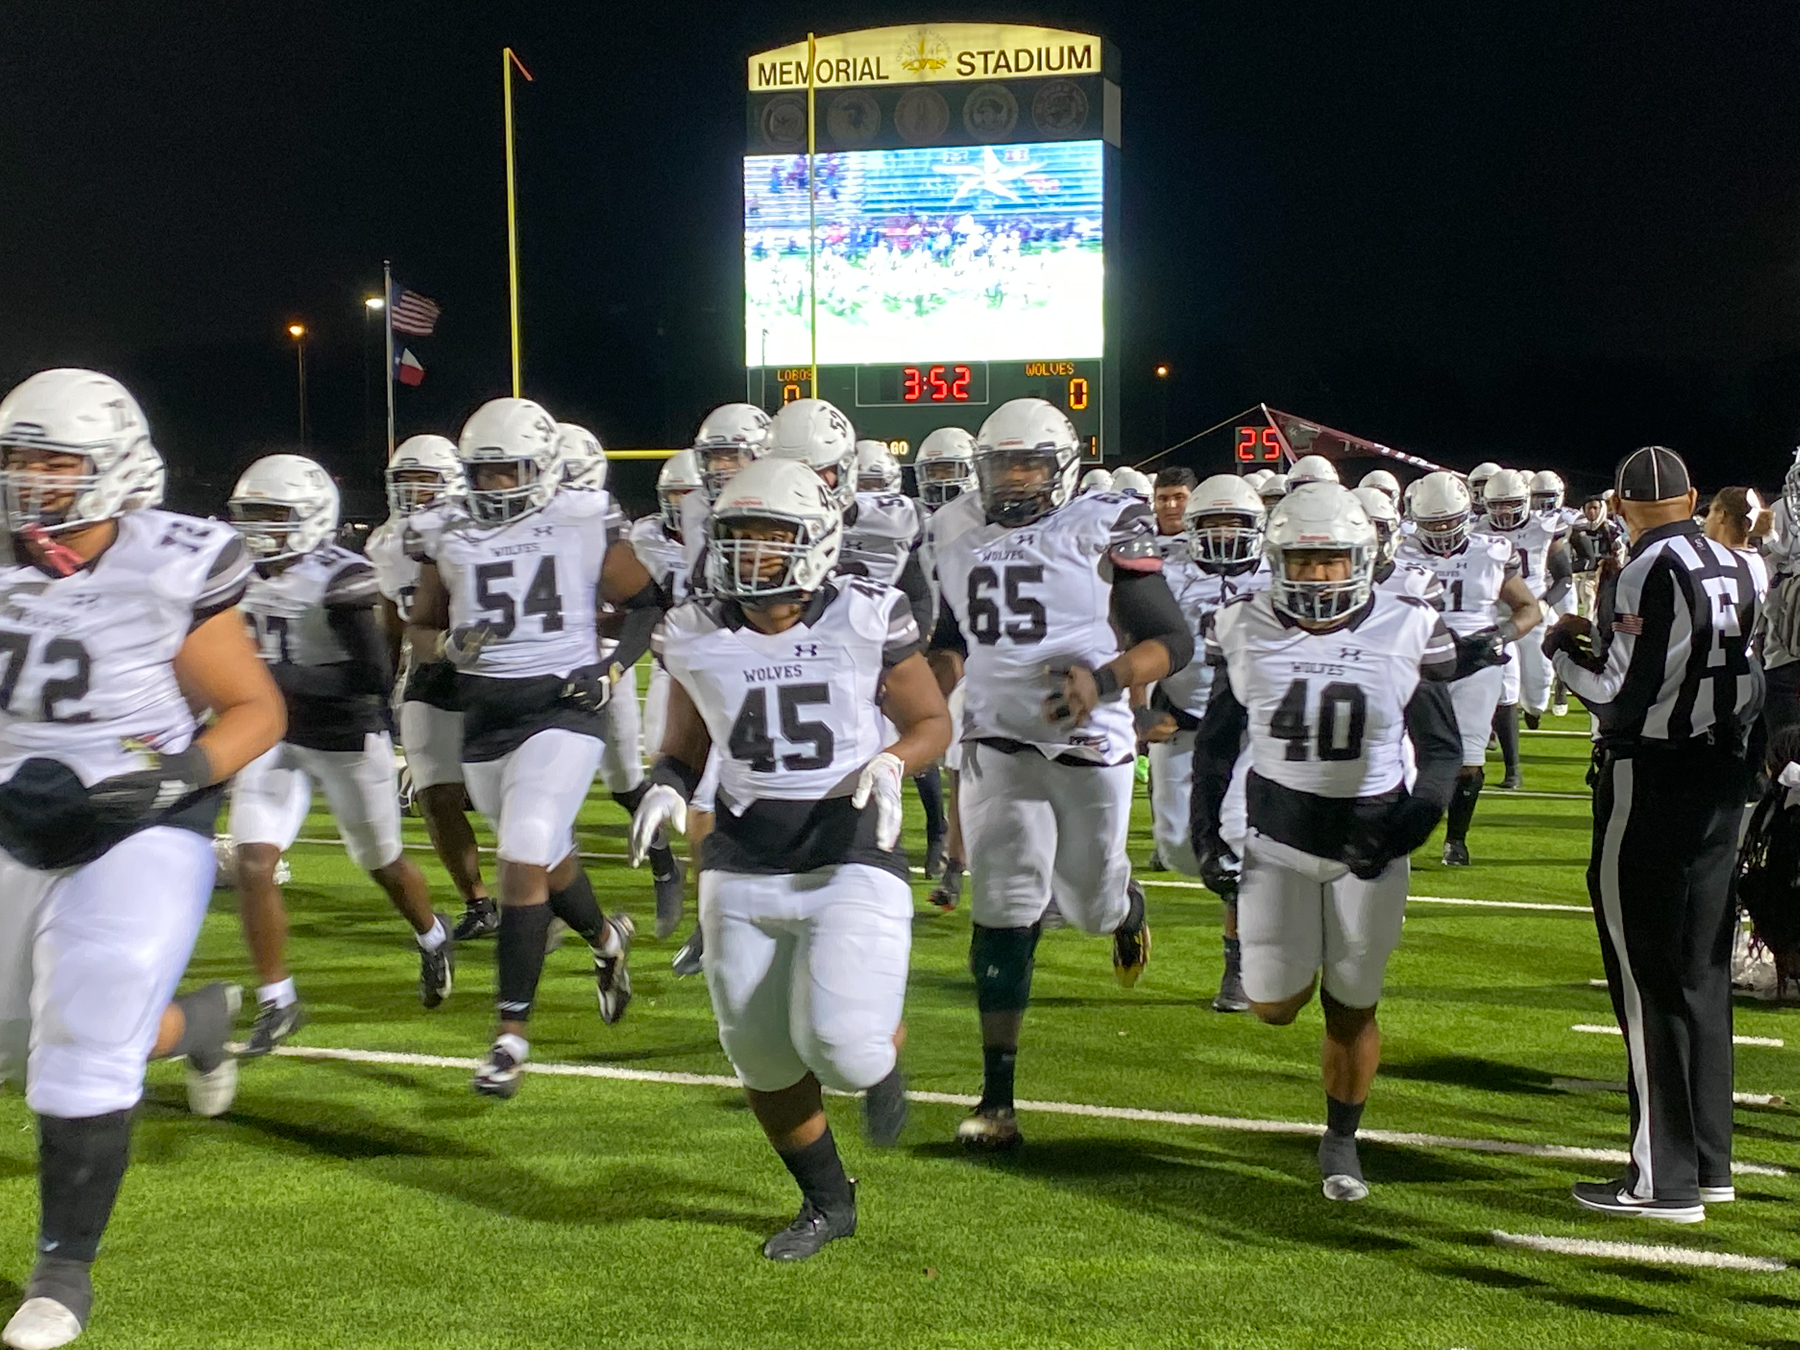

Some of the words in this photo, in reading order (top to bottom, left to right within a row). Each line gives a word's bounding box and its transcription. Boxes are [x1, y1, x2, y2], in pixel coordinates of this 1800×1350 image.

[757, 55, 890, 87] MEMORIAL
[956, 44, 1093, 77] STADIUM
[776, 368, 812, 382] LOBOS
[903, 366, 971, 400] 3:52
[1025, 362, 1075, 376] WOLVES
[1069, 378, 1088, 410] 0
[890, 440, 909, 456] GO
[1238, 427, 1281, 460] 25
[981, 550, 1024, 562] WOLVES
[475, 555, 564, 639] 54
[967, 565, 1048, 646] 65
[1701, 576, 1742, 668] F
[0, 630, 92, 723] 72
[743, 663, 804, 683] WOLVES
[728, 681, 835, 773] 45
[1269, 677, 1367, 762] 40
